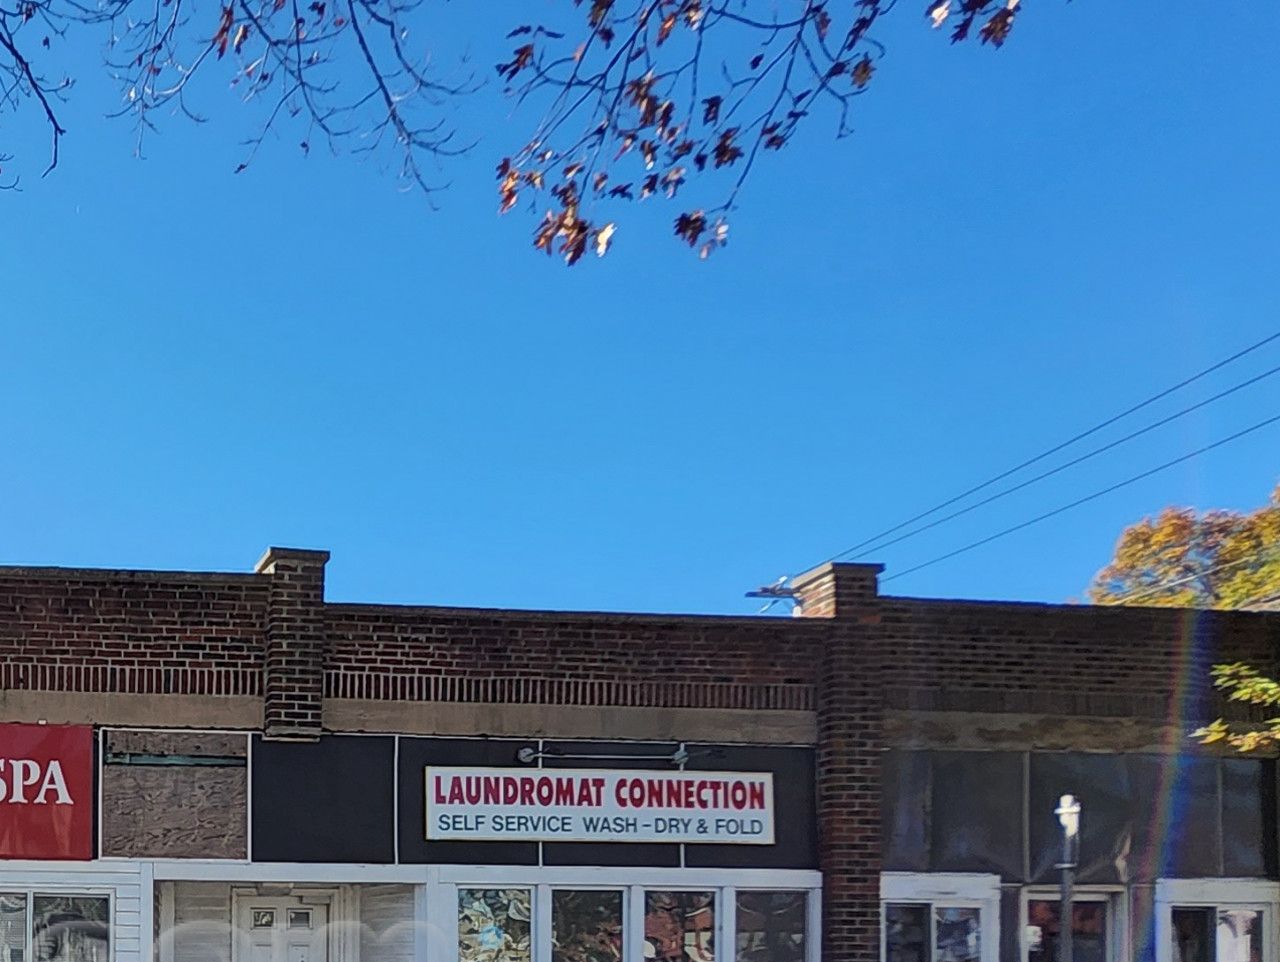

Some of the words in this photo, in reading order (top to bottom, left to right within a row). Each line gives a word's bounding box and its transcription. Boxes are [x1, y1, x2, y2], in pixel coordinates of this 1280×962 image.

[434, 775, 606, 807] LAUNDROMAT
[615, 777, 766, 810] CONNECTION
[438, 813, 486, 832] SELF
[491, 814, 573, 832] SERVICE
[696, 818, 709, 834] &
[715, 818, 764, 835] FOLD
